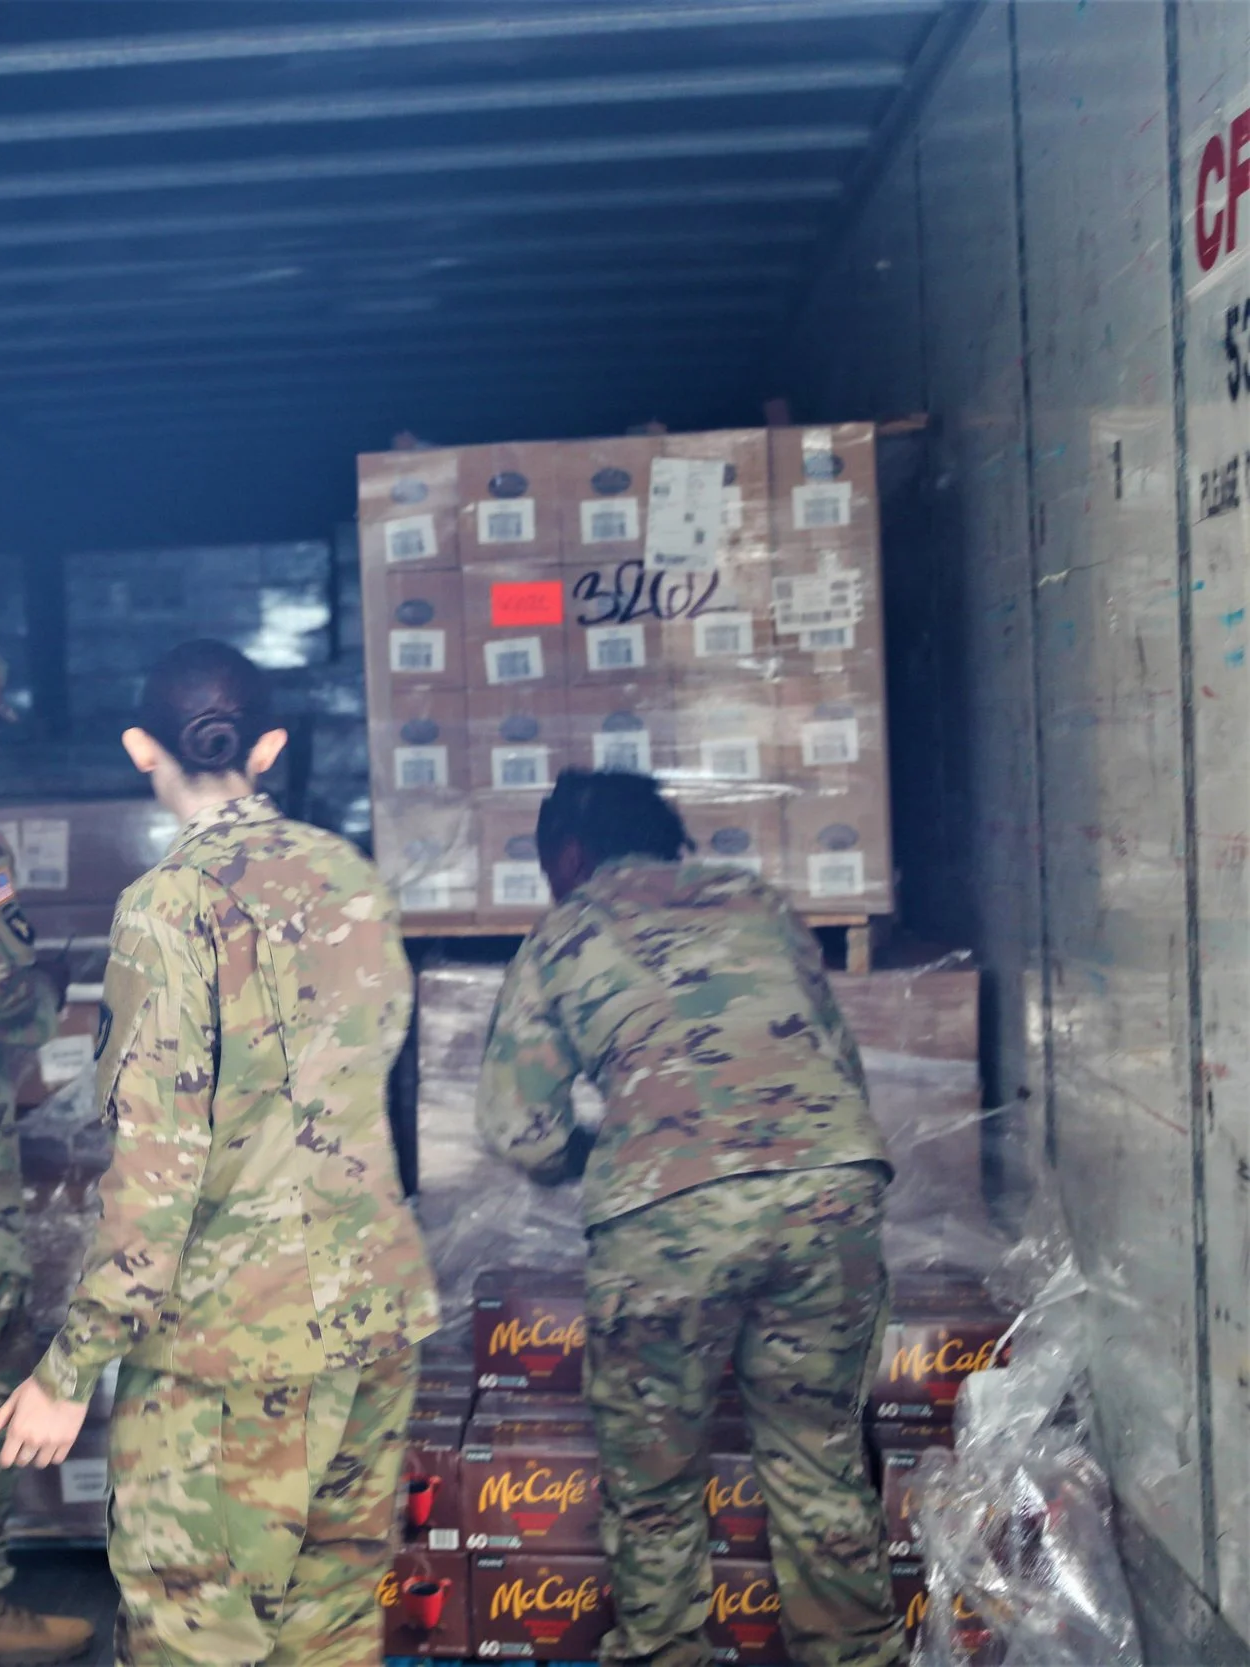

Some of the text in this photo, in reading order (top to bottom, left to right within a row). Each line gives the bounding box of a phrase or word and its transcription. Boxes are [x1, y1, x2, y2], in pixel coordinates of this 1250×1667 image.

[478, 1467, 587, 1514] McCafé
[888, 1540, 911, 1556] 60
[489, 1575, 598, 1621] McCafé
[478, 1640, 500, 1656] 60
